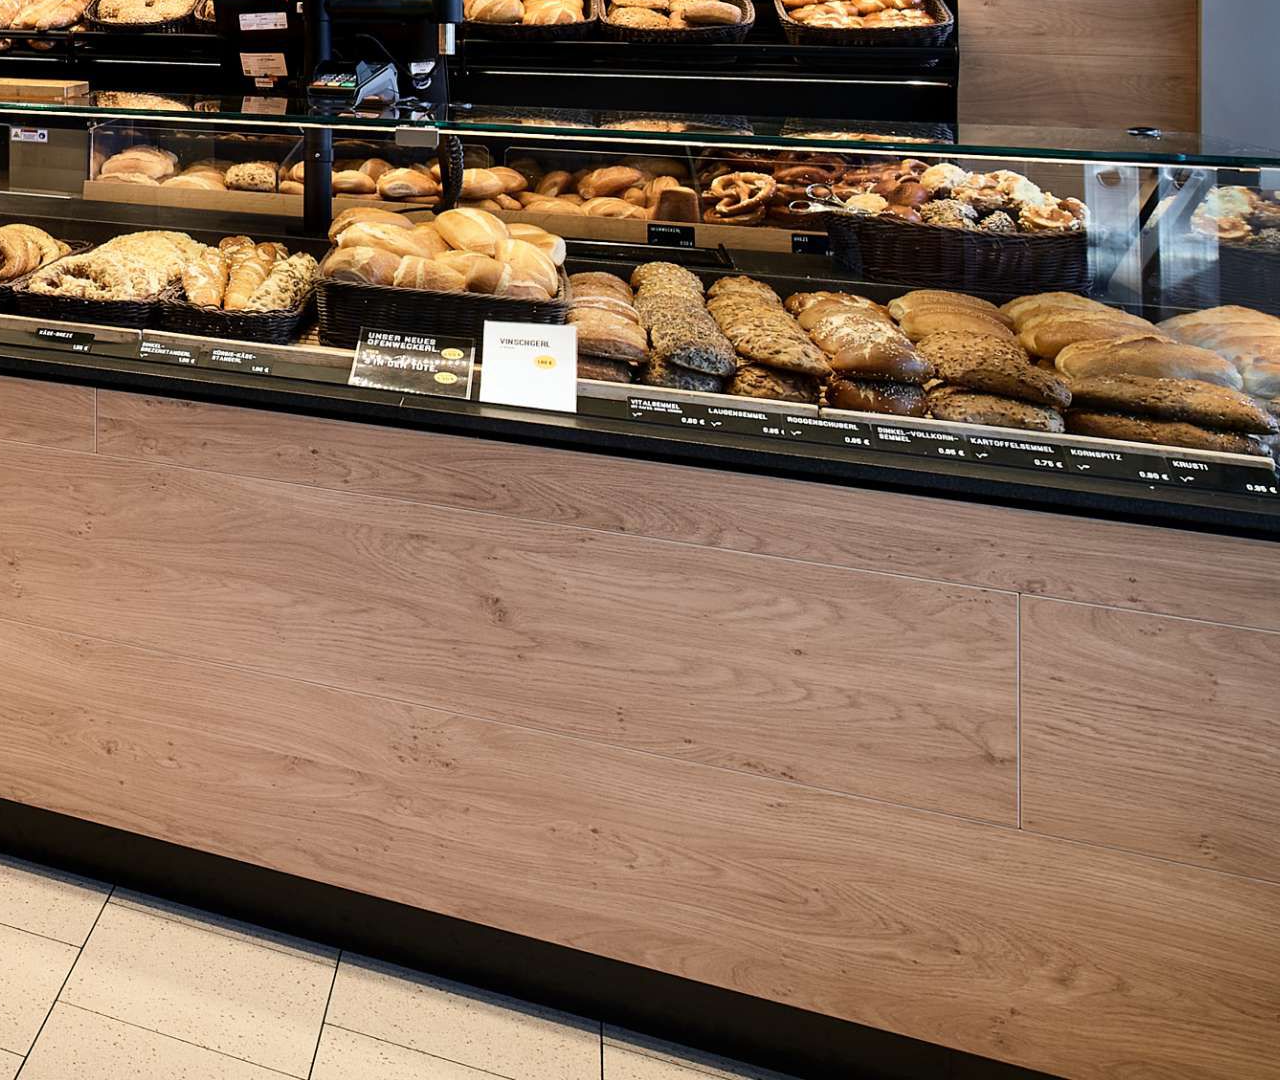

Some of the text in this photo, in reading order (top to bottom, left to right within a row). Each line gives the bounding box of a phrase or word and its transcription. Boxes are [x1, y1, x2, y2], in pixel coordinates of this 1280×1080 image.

[368, 331, 437, 346] UNSER NEUES
[630, 399, 680, 410] VITALSEMMEL
[707, 407, 768, 421] LAUGENSEMMEL
[878, 433, 911, 443] SEMMEL
[970, 437, 1055, 454] KARTOFFELSEMMEL
[1070, 449, 1123, 461] KORNSPITZ
[1172, 460, 1209, 471] KRUSTI
